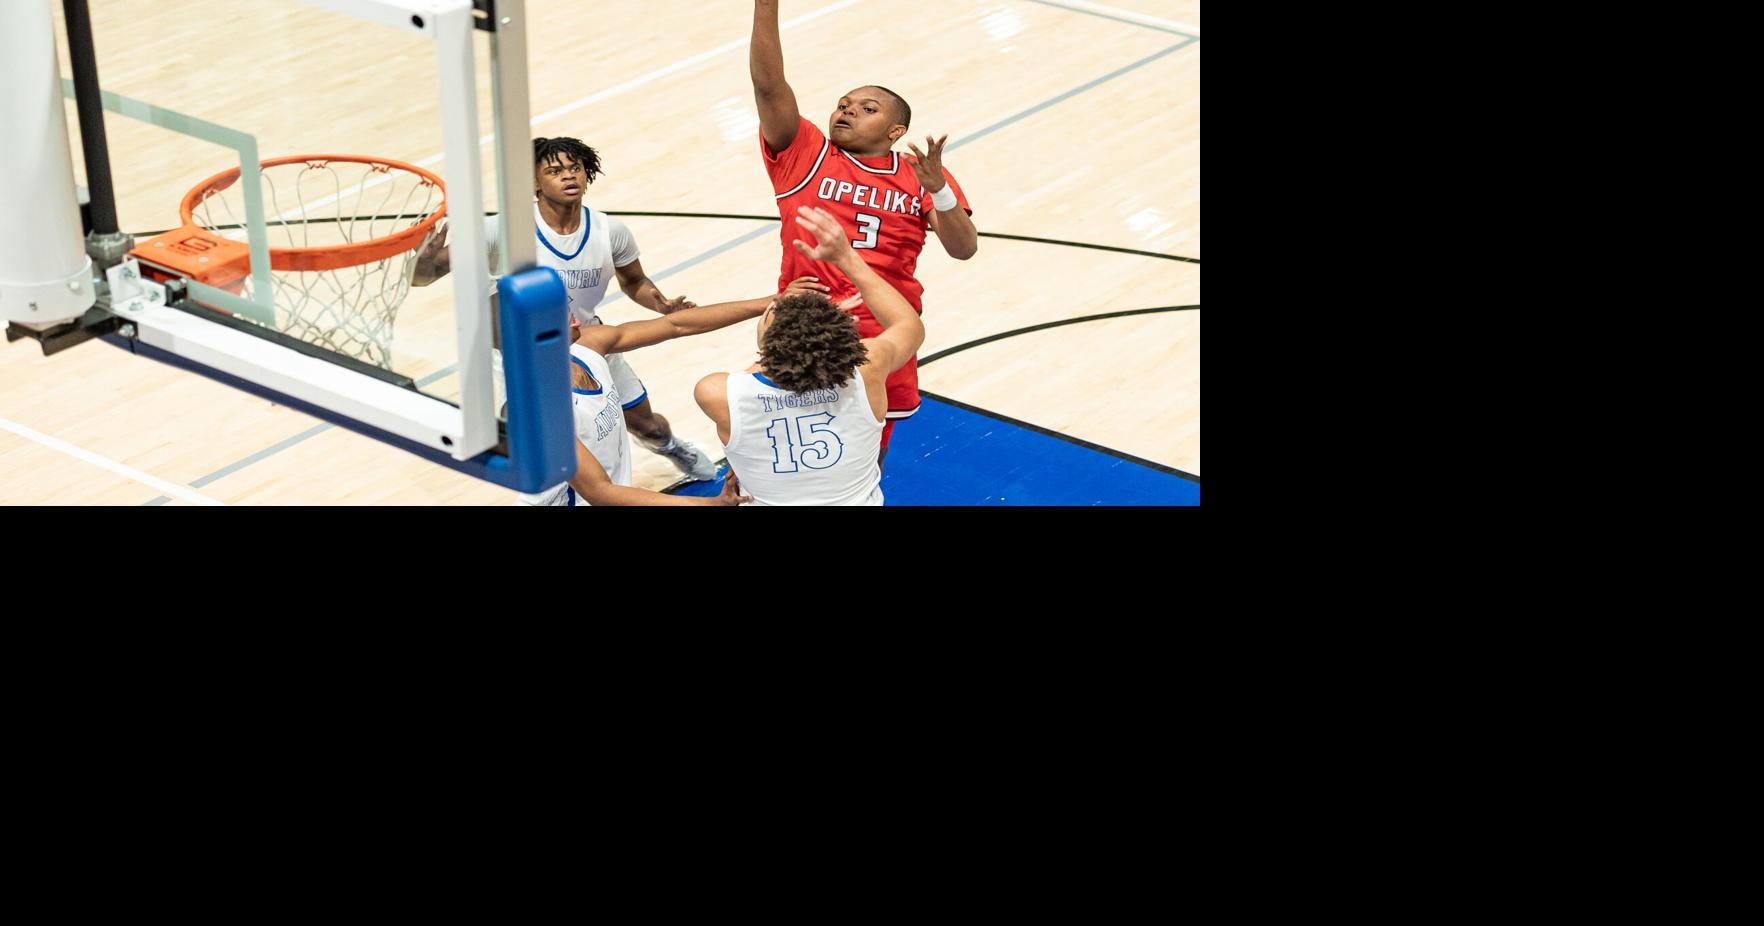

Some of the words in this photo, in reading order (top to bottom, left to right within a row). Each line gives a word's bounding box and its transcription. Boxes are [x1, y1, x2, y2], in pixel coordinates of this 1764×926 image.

[851, 211, 882, 249] 3
[758, 385, 840, 413] TIGERS
[766, 411, 844, 474] 15
